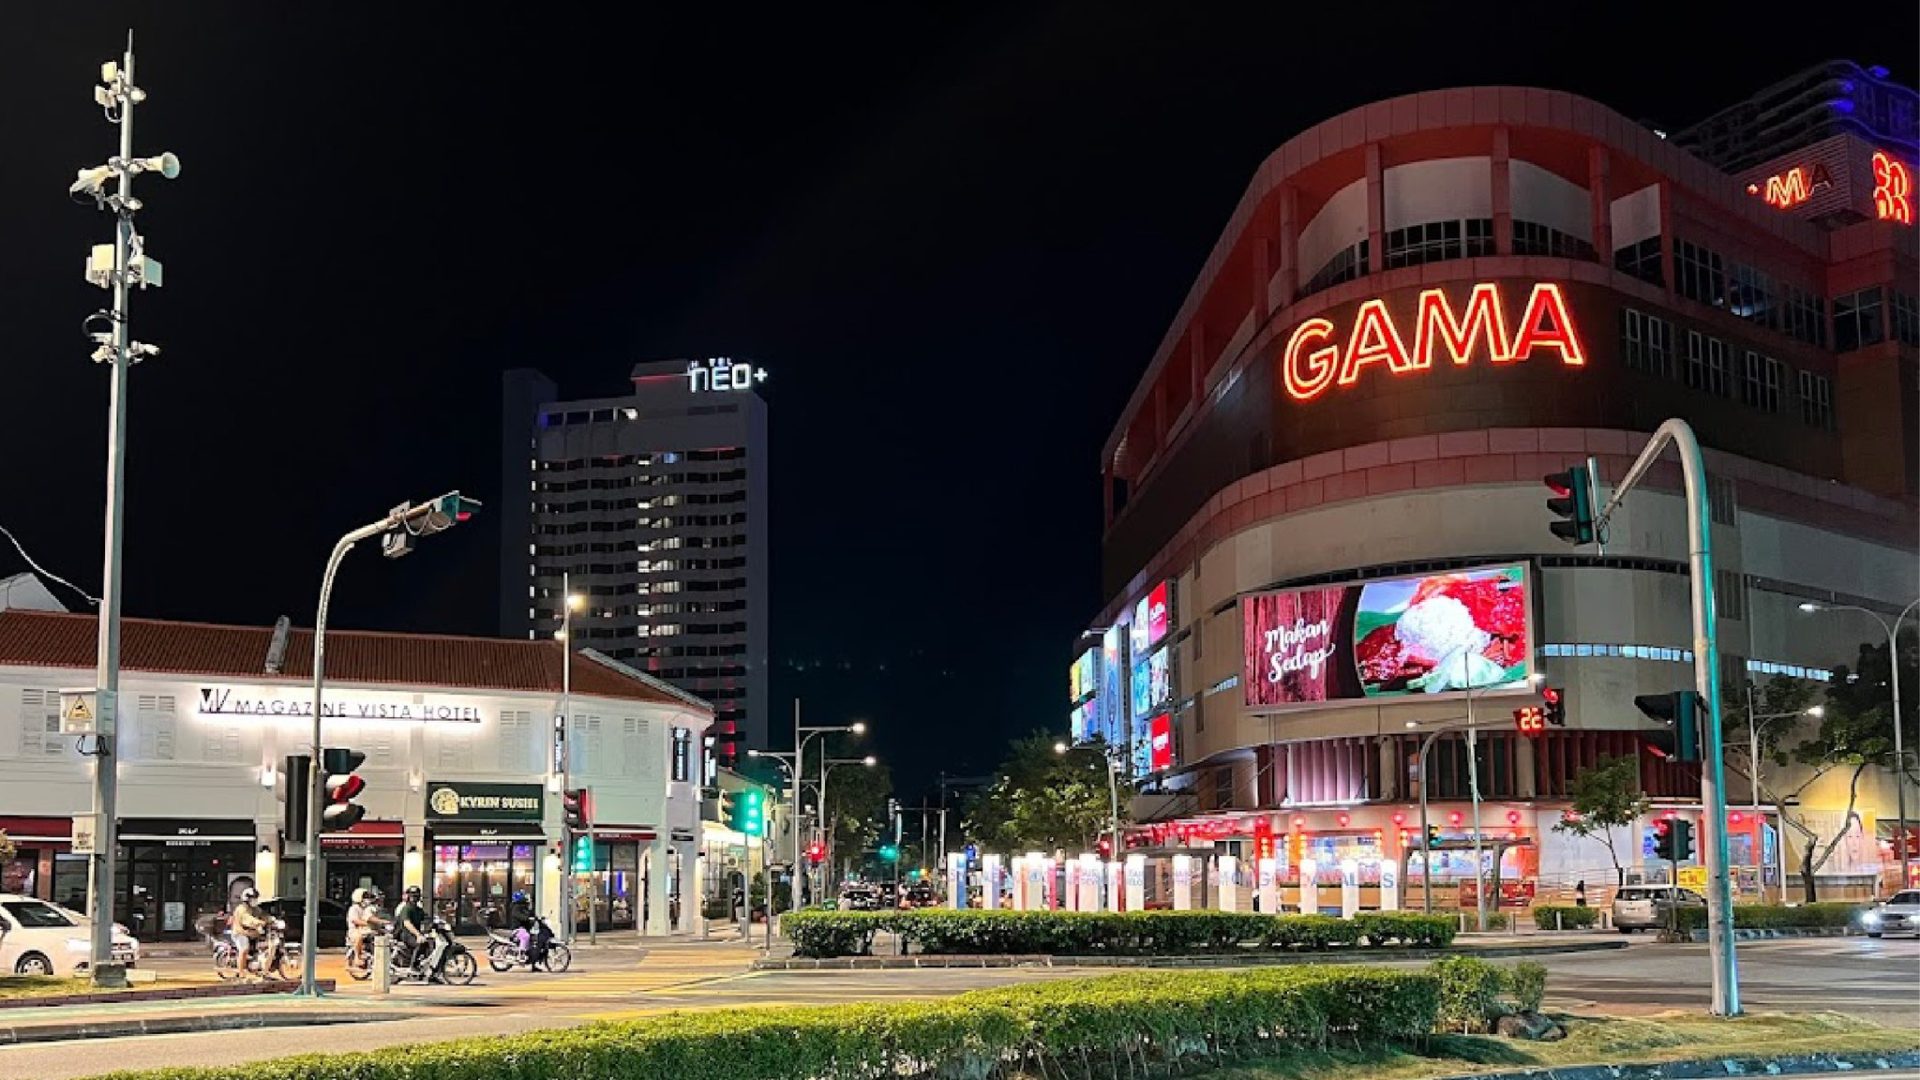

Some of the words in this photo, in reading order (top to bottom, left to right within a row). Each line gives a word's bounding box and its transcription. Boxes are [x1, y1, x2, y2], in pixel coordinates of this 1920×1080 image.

[1284, 283, 1585, 399] GAMA
[1264, 618, 1328, 653] Makan
[1268, 643, 1336, 682] Sedap
[234, 700, 347, 718] MAGAZNE
[358, 703, 412, 719] VISTA
[423, 704, 481, 722] HOTEL
